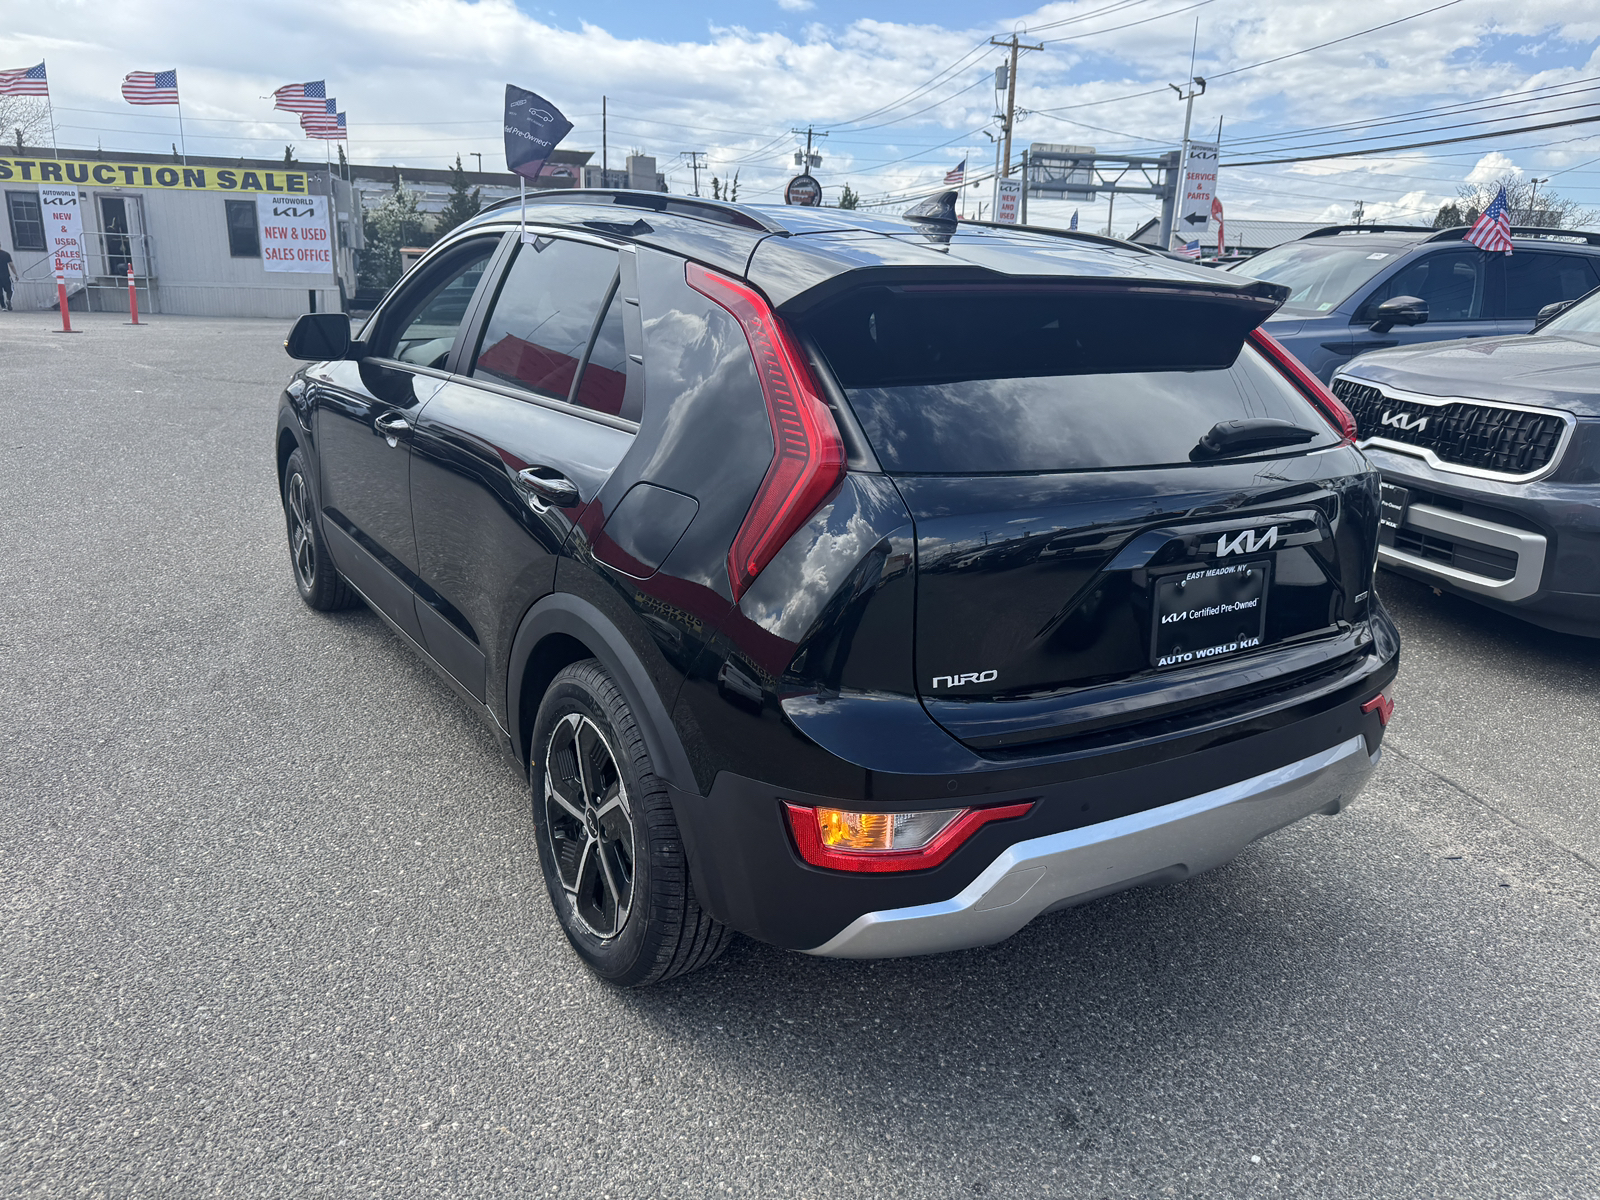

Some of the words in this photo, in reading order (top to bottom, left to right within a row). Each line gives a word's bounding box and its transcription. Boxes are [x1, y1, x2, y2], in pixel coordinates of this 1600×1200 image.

[1190, 151, 1217, 160] KIA
[1187, 172, 1216, 181] SERVICE
[217, 170, 305, 193] SALE
[1187, 192, 1210, 200] PARTS
[43, 197, 77, 206] KIA
[272, 197, 313, 205] AUTOWORLD
[1002, 203, 1014, 211] AND
[52, 212, 72, 221] NEW
[273, 206, 314, 218] KIA
[1000, 212, 1015, 220] USED
[61, 225, 68, 233] &
[264, 226, 288, 239] NEW
[291, 227, 299, 240] &
[301, 227, 327, 241] USED
[55, 237, 77, 246] USED
[55, 250, 80, 259] SALES
[265, 247, 295, 261] SALES
[297, 248, 330, 262] OFFICE
[1381, 409, 1430, 433] KIA
[1216, 526, 1278, 558] KIA
[1186, 571, 1205, 580] EAST
[1237, 564, 1247, 573] NY
[1161, 611, 1187, 624] KIA
[1189, 605, 1220, 620] Certified
[1158, 653, 1192, 667] AUTO
[1195, 643, 1237, 659] WORLD
[1240, 638, 1260, 649] KIA
[932, 669, 998, 689] NIRO
